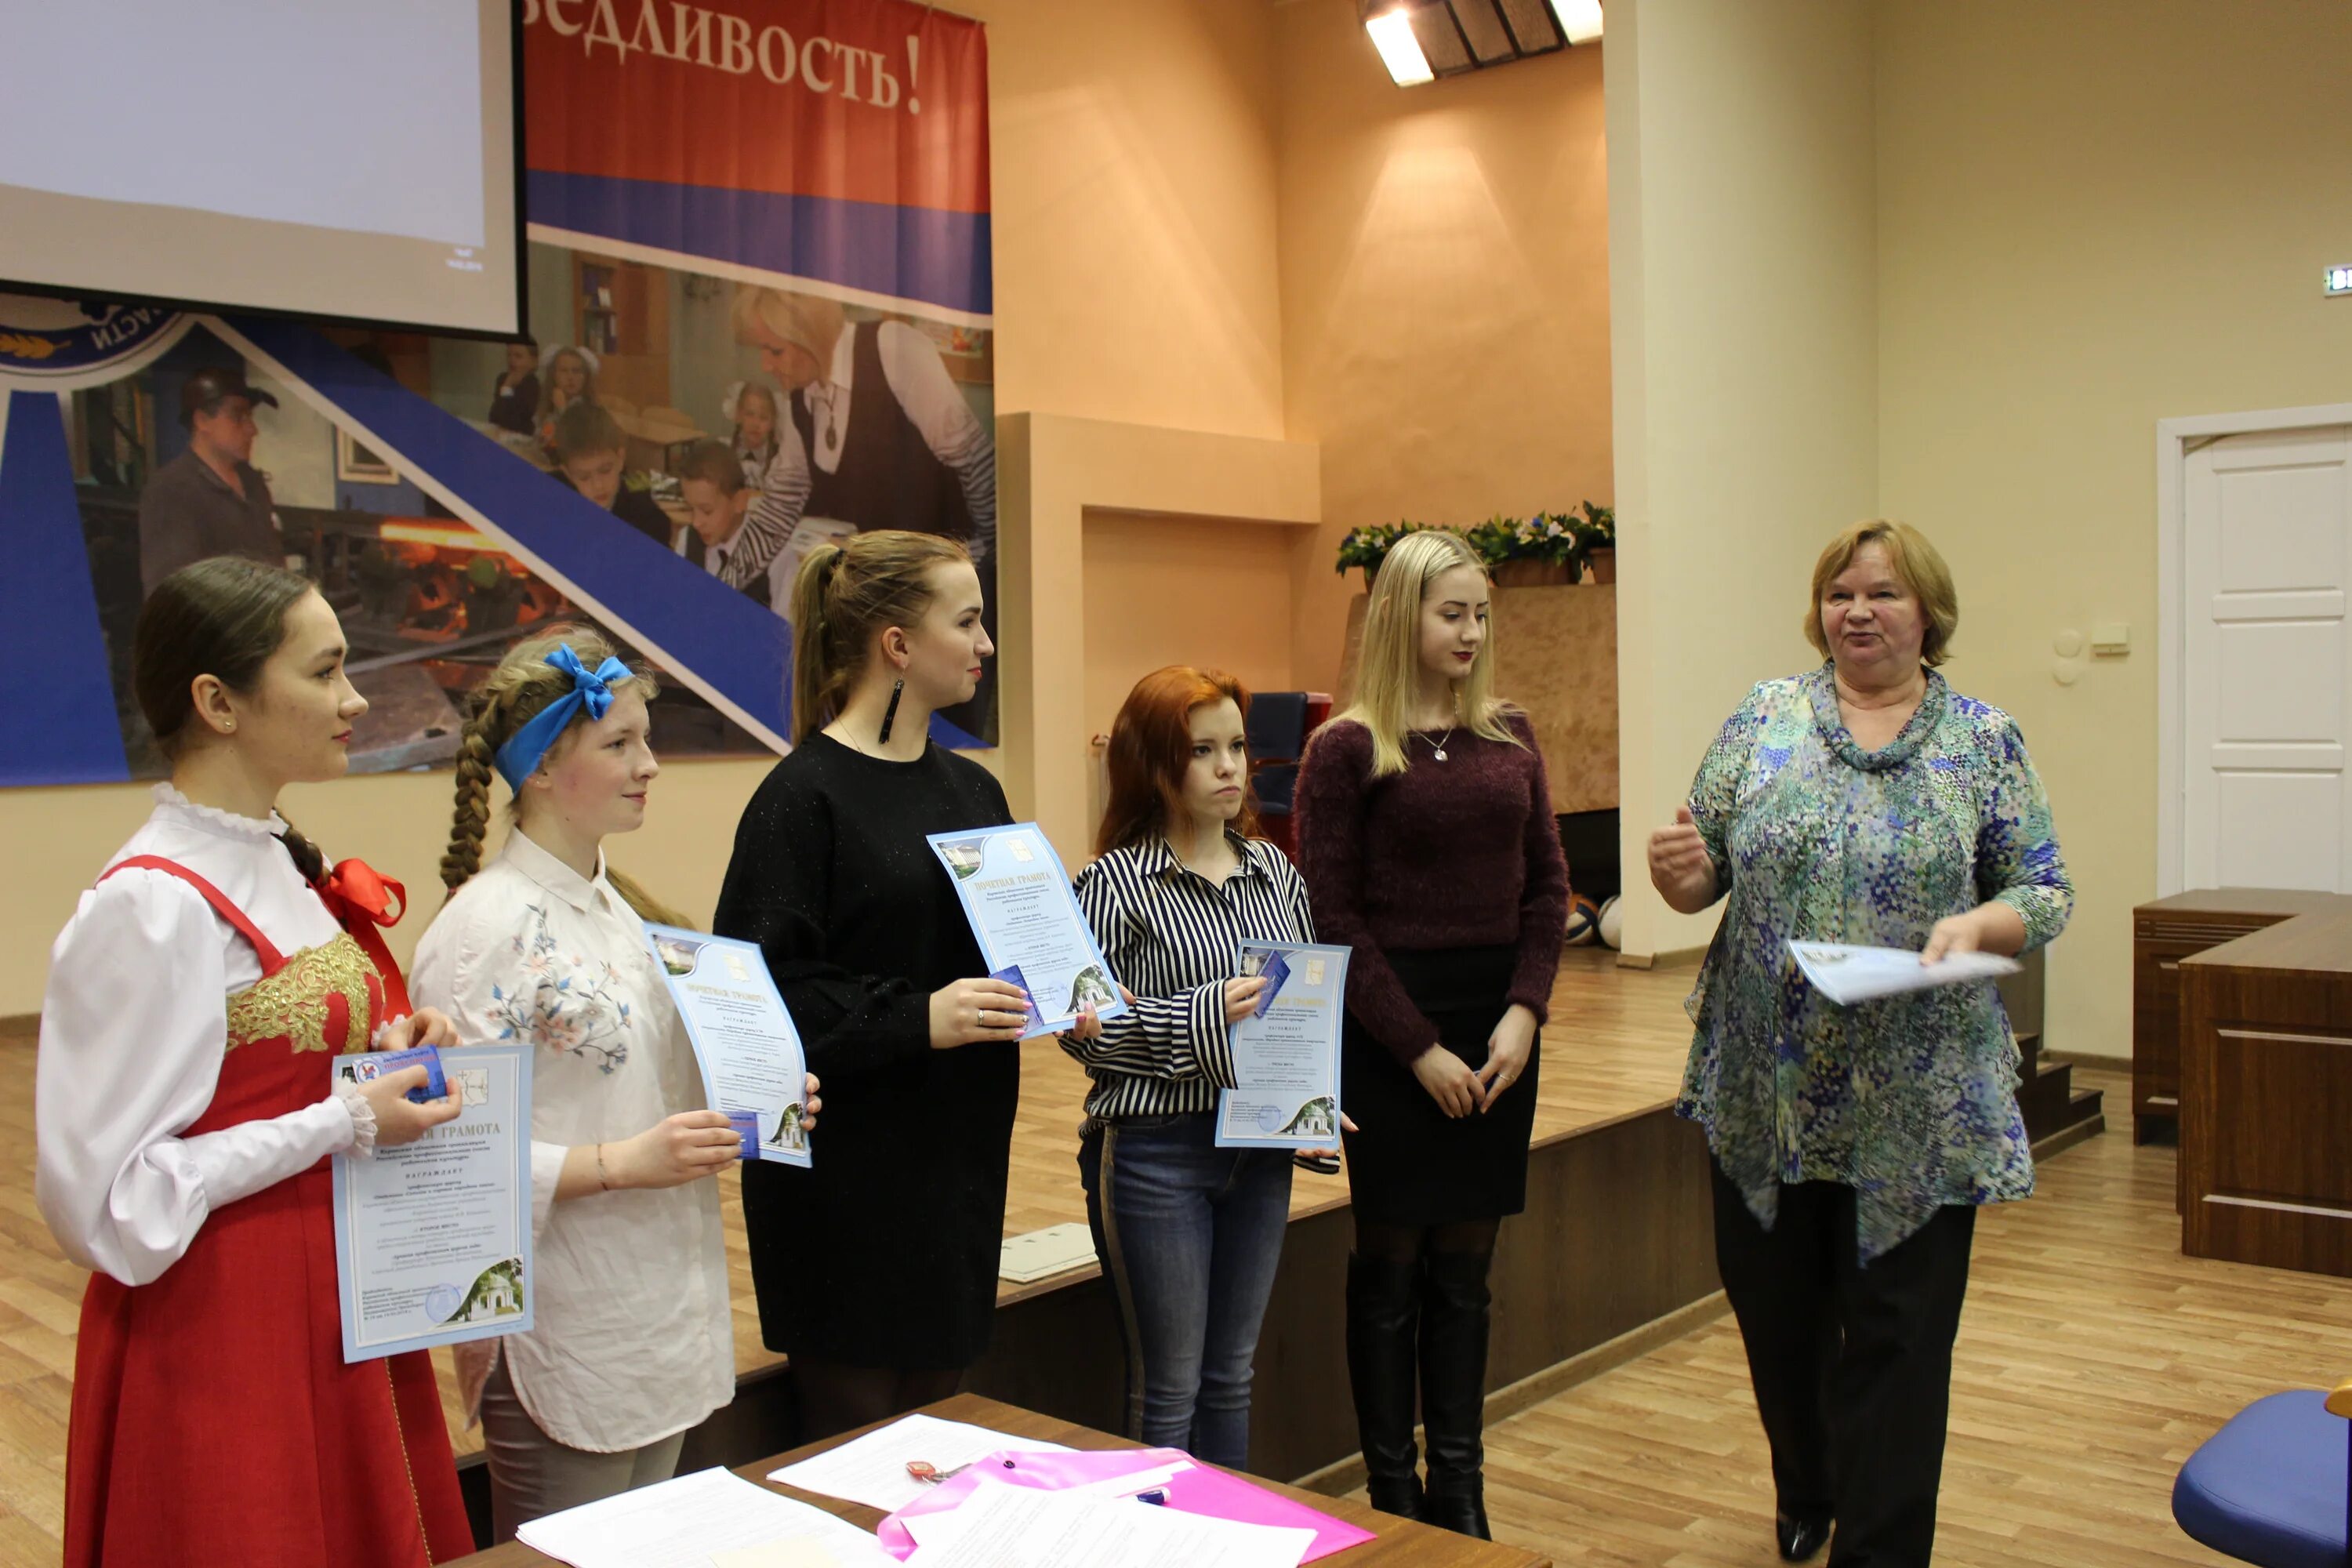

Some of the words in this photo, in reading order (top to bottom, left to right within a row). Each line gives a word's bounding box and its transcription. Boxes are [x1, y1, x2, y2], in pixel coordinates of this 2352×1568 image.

[523, 0, 920, 115] ЕДЛИВОСТЬ!
[90, 307, 162, 350] АСТИ
[441, 1122, 501, 1139] ГРАМОТА
